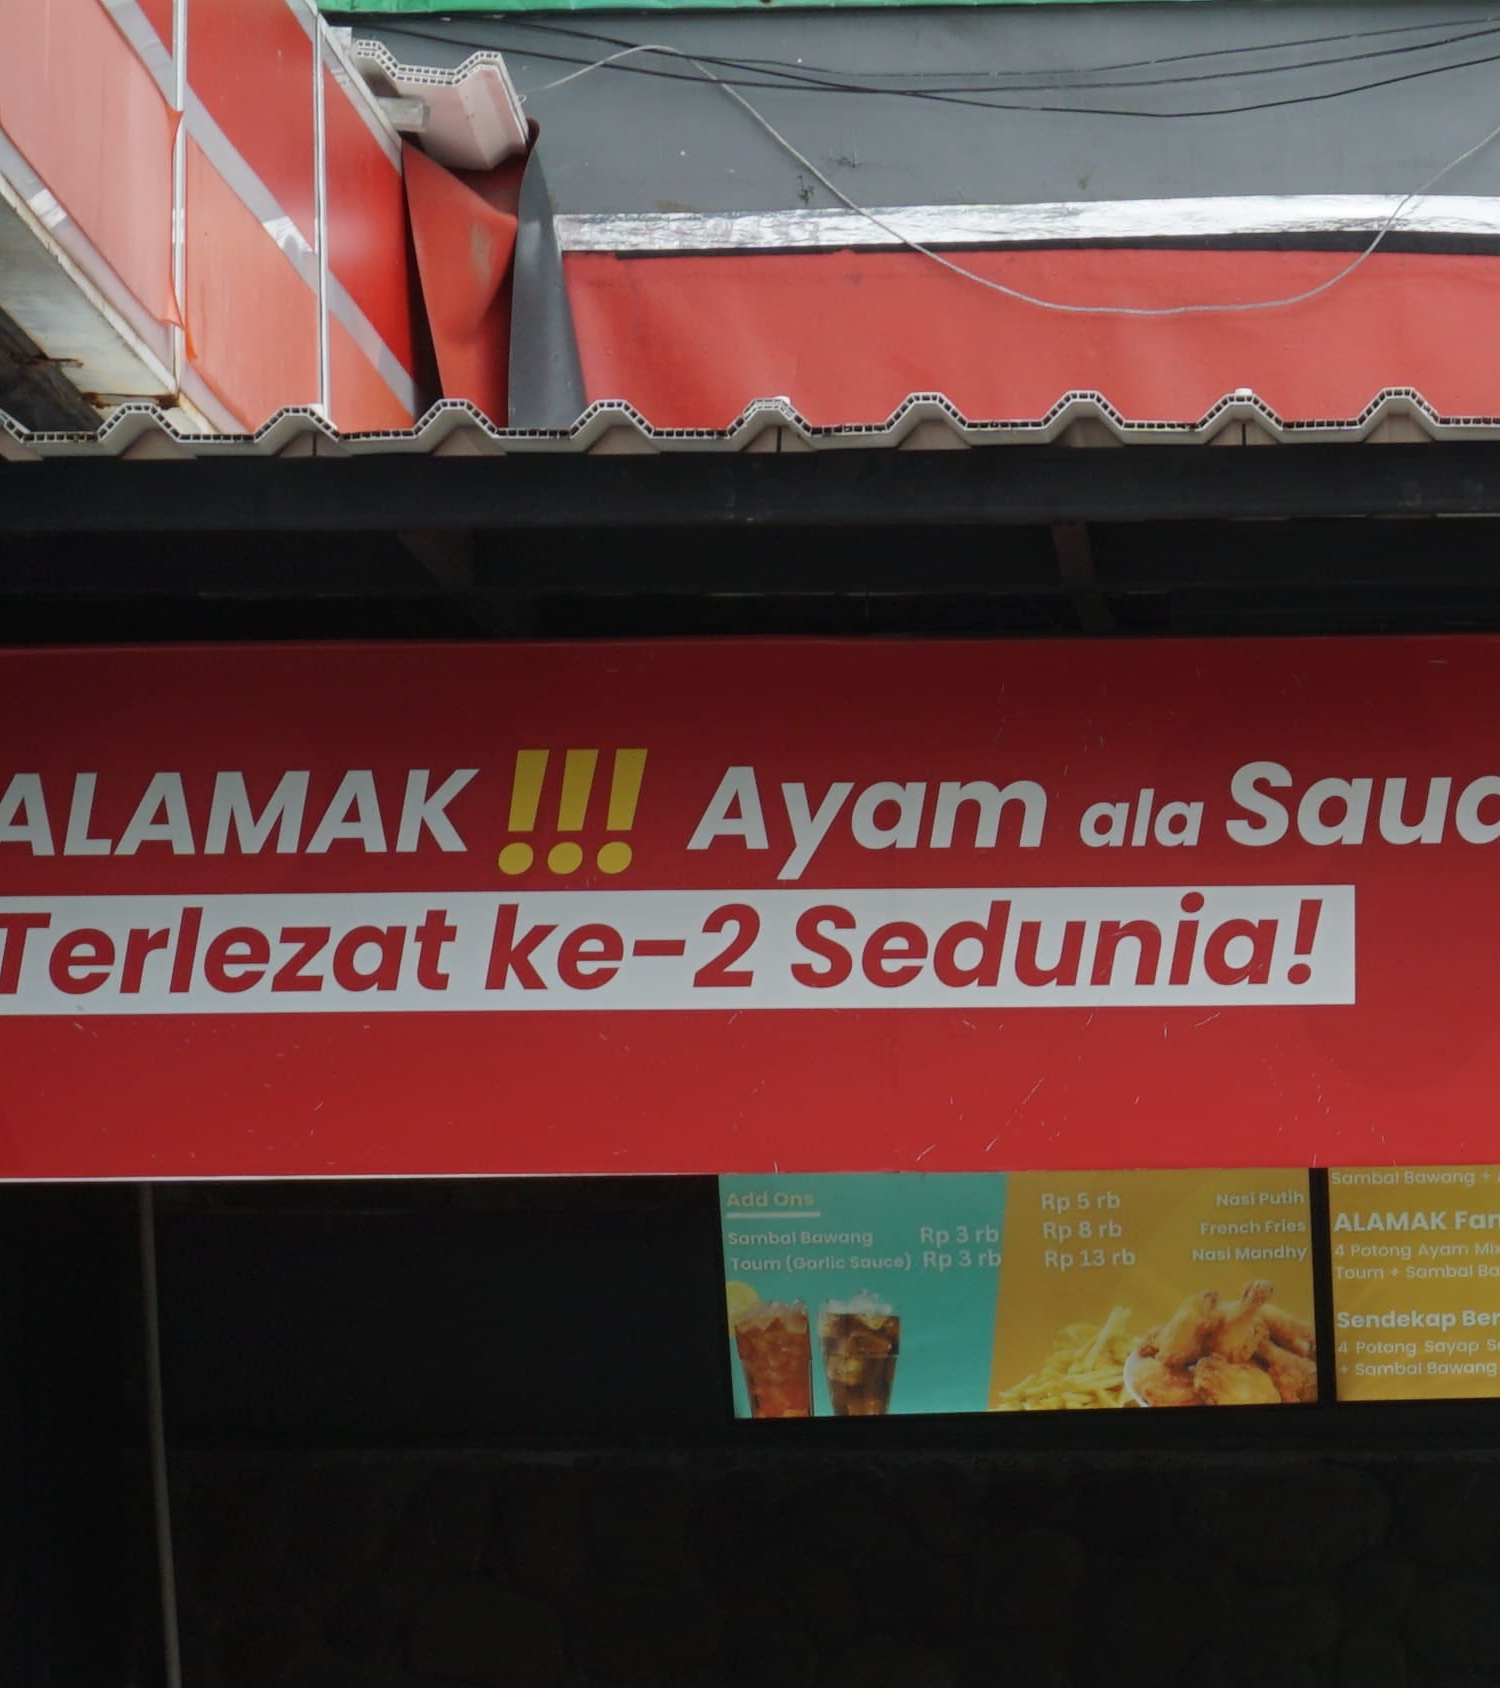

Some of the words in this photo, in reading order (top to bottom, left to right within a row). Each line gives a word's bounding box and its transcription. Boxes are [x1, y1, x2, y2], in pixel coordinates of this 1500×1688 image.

[498, 748, 647, 874] !!!
[687, 765, 1047, 880] Ayam
[1079, 788, 1204, 847] ala
[484, 904, 760, 991] ke-2
[790, 892, 1324, 989] Sedunia!
[1331, 1169, 1399, 1185] Sambal
[1404, 1170, 1475, 1187] Bawang
[725, 1192, 768, 1207] Add
[1041, 1194, 1071, 1213] Rp
[1077, 1193, 1090, 1209] 5
[1097, 1192, 1121, 1209] rb
[1216, 1192, 1255, 1207] Nasi
[1260, 1191, 1305, 1205] Putih
[1043, 1222, 1072, 1243] Rp
[1079, 1221, 1092, 1238] 8
[1099, 1220, 1122, 1238] rb
[1200, 1220, 1260, 1235] French
[1265, 1219, 1306, 1233] Fries
[1334, 1211, 1448, 1232] ALAMAK
[728, 1230, 796, 1245] Sambal
[801, 1230, 873, 1247] Bawang
[920, 1226, 949, 1247] Rp
[956, 1226, 969, 1243] 3
[976, 1225, 999, 1243] rb
[731, 1256, 781, 1272] Toum
[786, 1254, 844, 1273] (Garlic
[850, 1253, 912, 1271] Sauce)
[923, 1250, 952, 1271] Rp
[959, 1250, 972, 1267] 3
[979, 1249, 1002, 1267] rb
[1045, 1251, 1073, 1271] Rp
[1080, 1249, 1105, 1267] 13
[1112, 1249, 1136, 1266] rb
[1192, 1247, 1231, 1262] Nasi
[1351, 1243, 1411, 1260] Potong
[1417, 1242, 1469, 1260] Ayam
[1335, 1265, 1384, 1279] Toum
[1406, 1263, 1472, 1278] Sambal
[1337, 1310, 1457, 1332] Sendekap
[1424, 1339, 1479, 1356] Sayap
[1355, 1362, 1421, 1376] Sambal
[1427, 1360, 1498, 1377] Bawang
